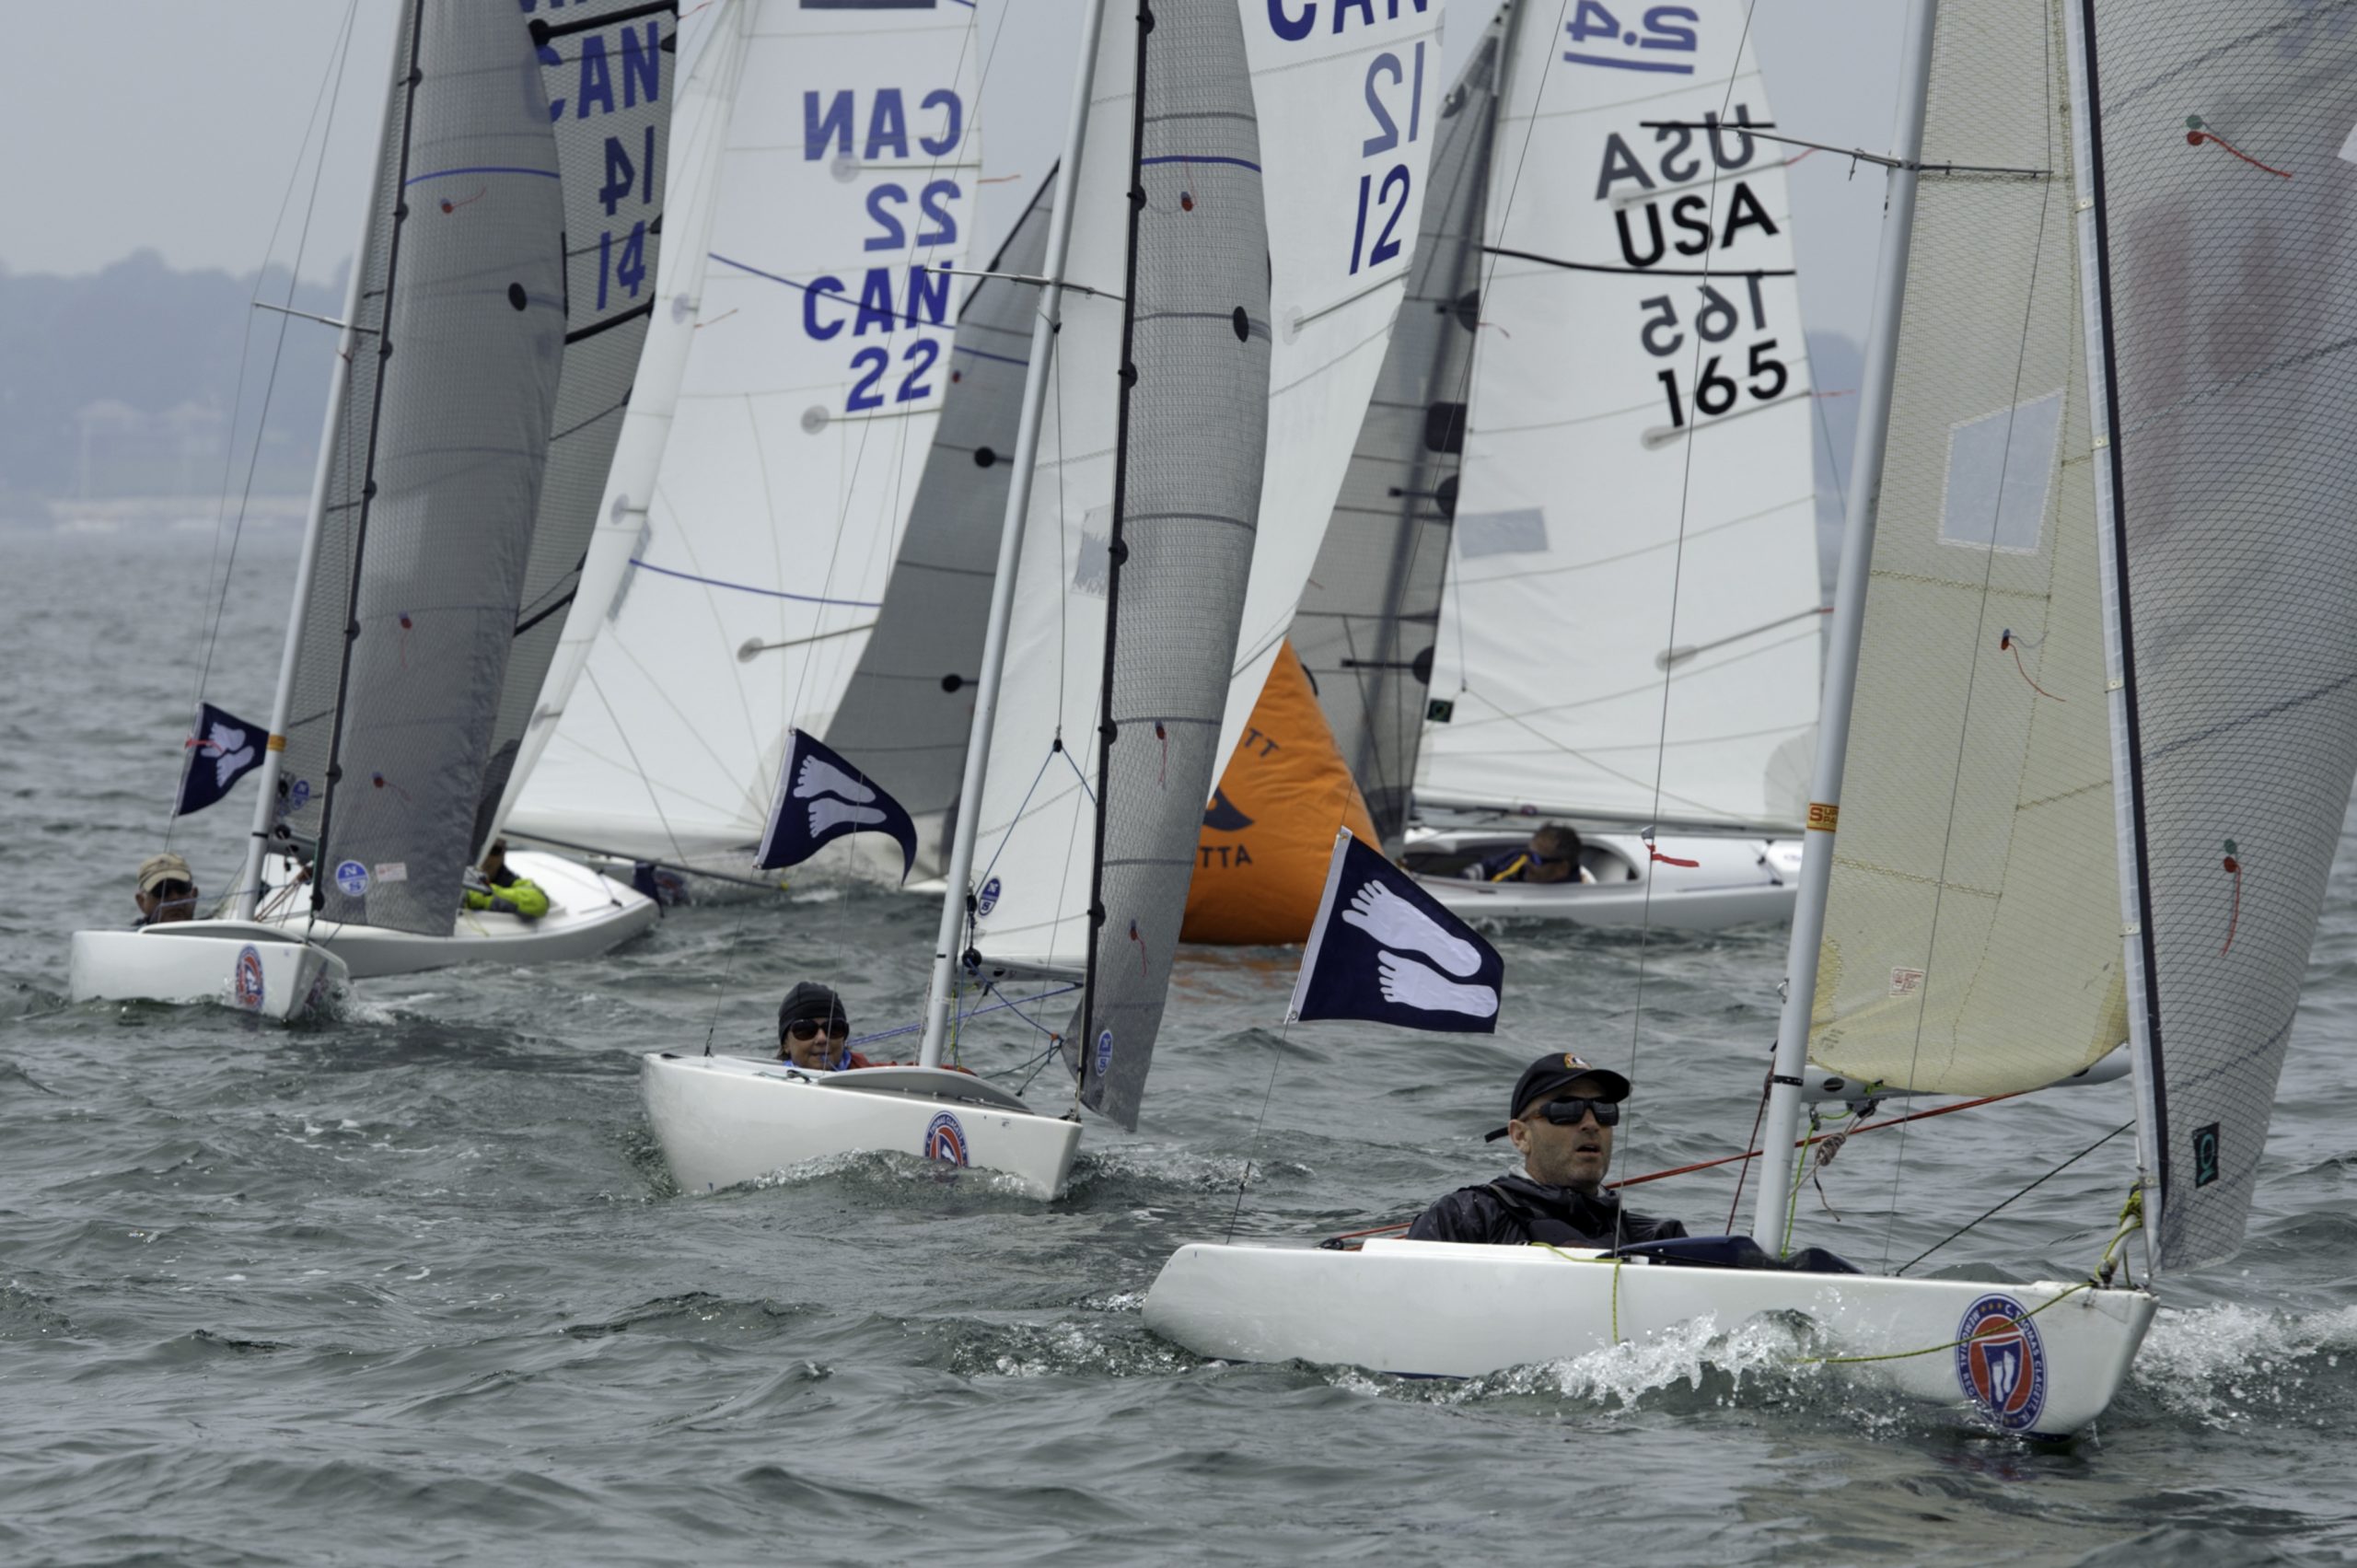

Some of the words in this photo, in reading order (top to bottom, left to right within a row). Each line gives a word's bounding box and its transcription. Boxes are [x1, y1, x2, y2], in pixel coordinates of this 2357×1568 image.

[1349, 163, 1411, 275] 12
[1613, 181, 1780, 269] USA
[596, 220, 645, 311] 14
[802, 260, 954, 342] CAN
[845, 338, 940, 413] 22
[1656, 338, 1788, 429] 165
